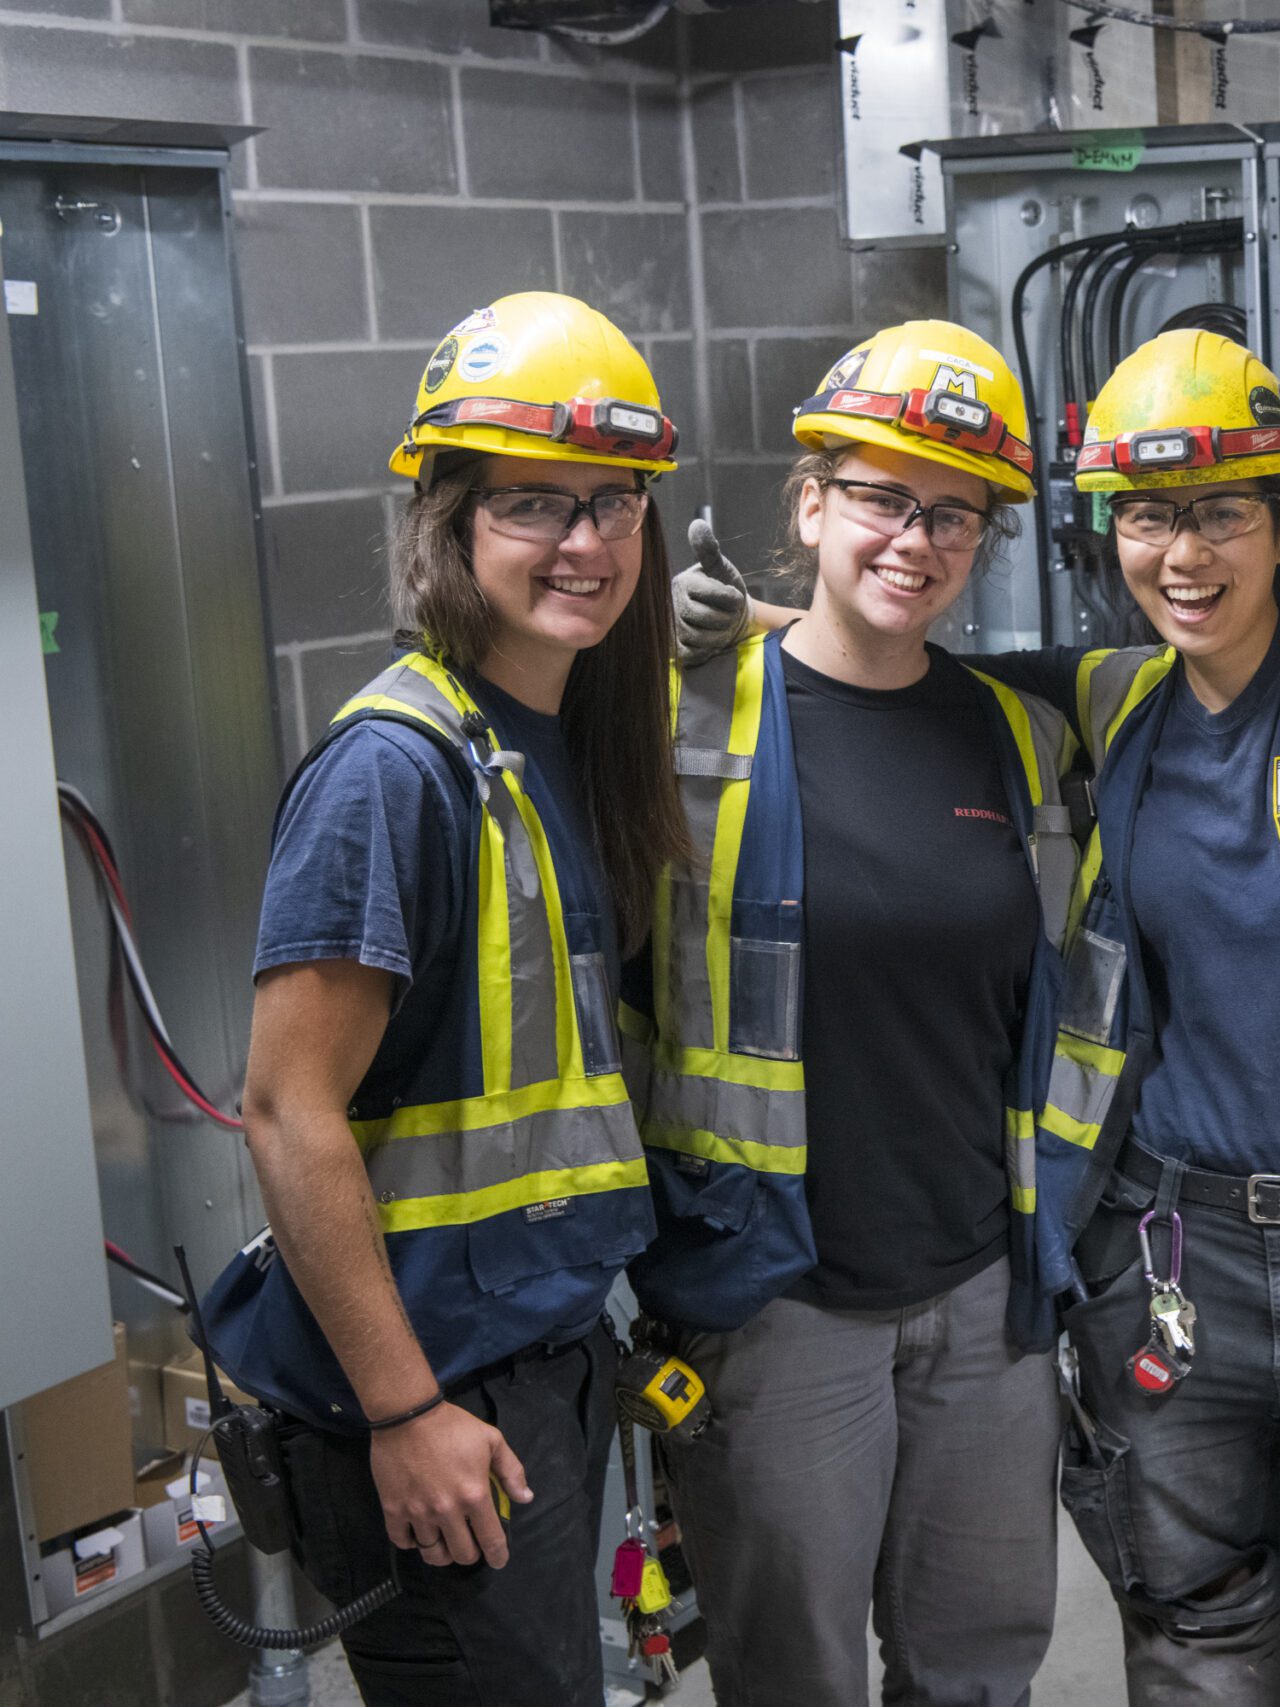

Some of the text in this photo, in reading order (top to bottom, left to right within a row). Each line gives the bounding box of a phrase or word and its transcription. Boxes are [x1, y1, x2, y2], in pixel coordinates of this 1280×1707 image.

[850, 60, 861, 120] viaduct
[966, 53, 979, 117] viaduct
[1086, 52, 1105, 111] viaduct
[1215, 48, 1229, 110] viaduct
[915, 165, 926, 224] viaduct
[526, 1203, 545, 1214] STAR
